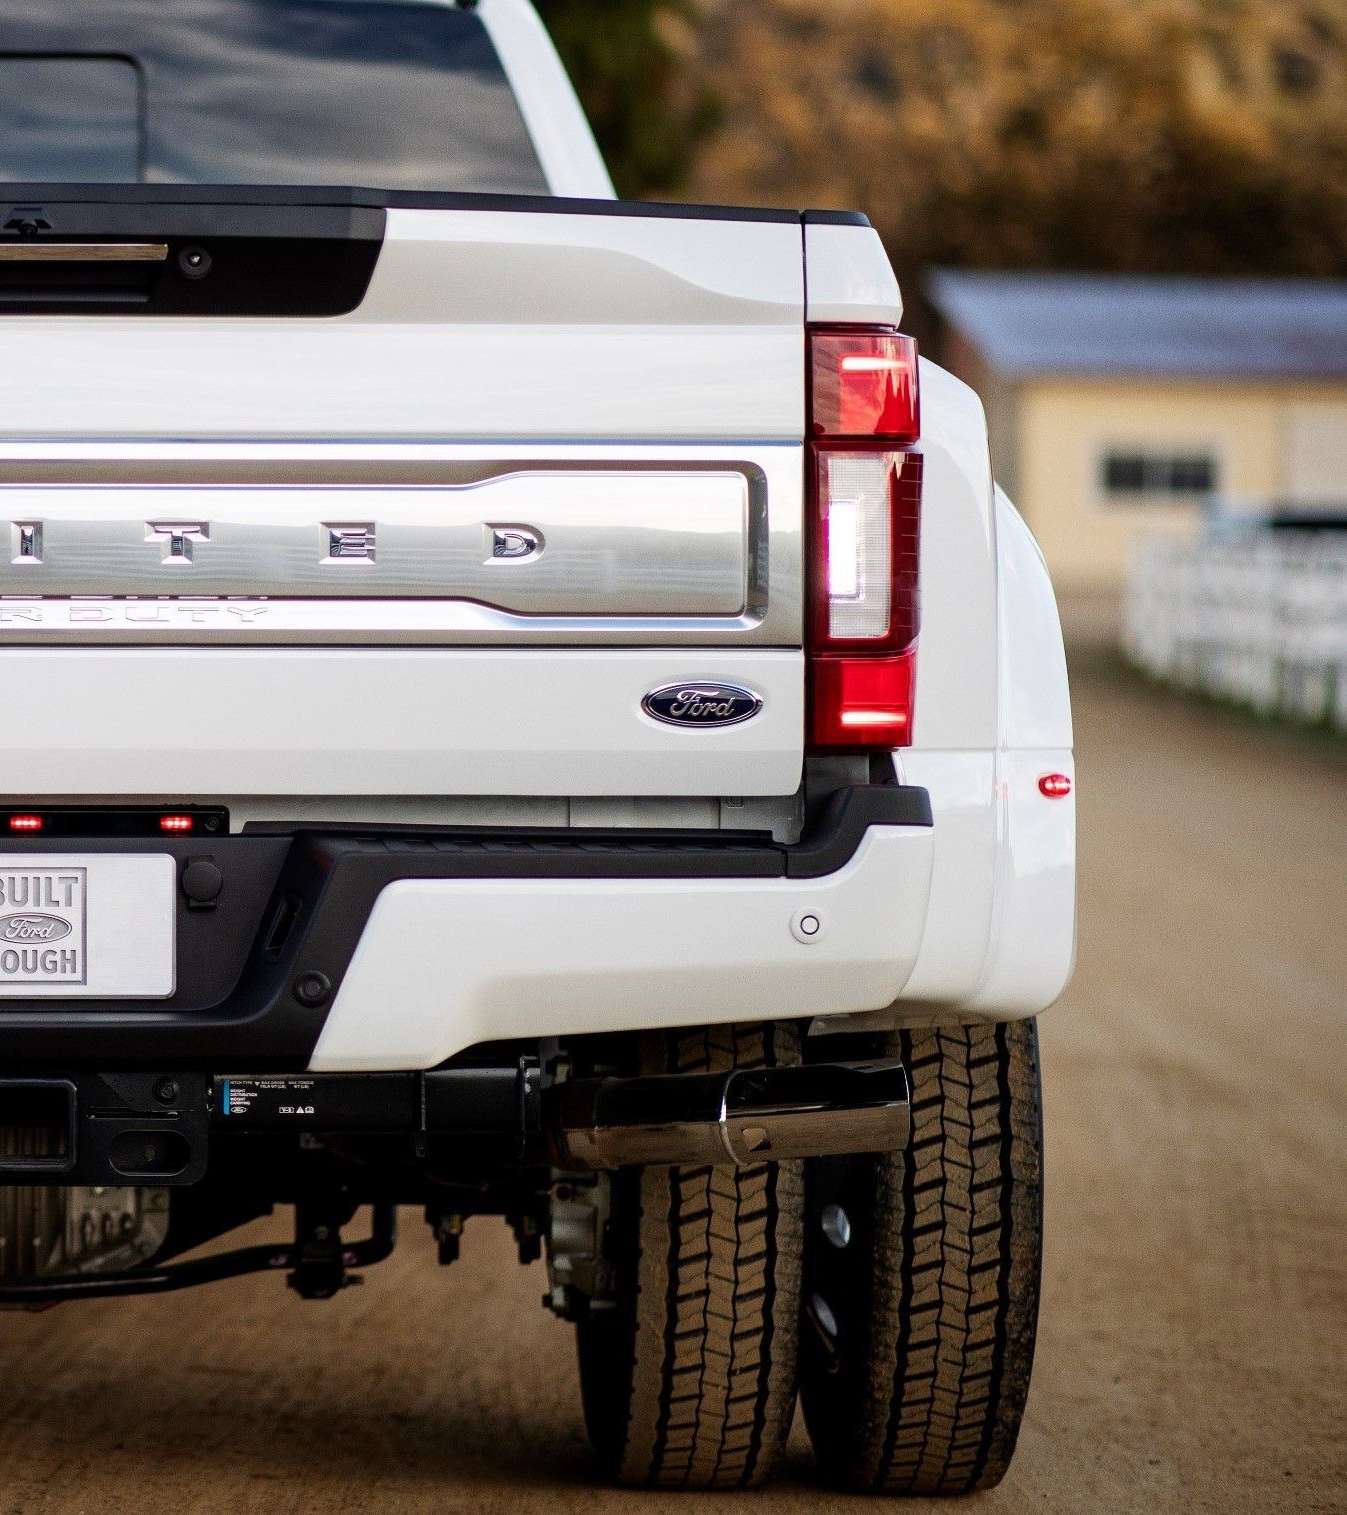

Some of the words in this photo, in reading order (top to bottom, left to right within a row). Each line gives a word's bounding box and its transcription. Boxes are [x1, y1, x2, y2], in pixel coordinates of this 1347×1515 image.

[70, 598, 268, 622] DUTY
[669, 689, 736, 717] Ford
[5, 916, 55, 939] Ford
